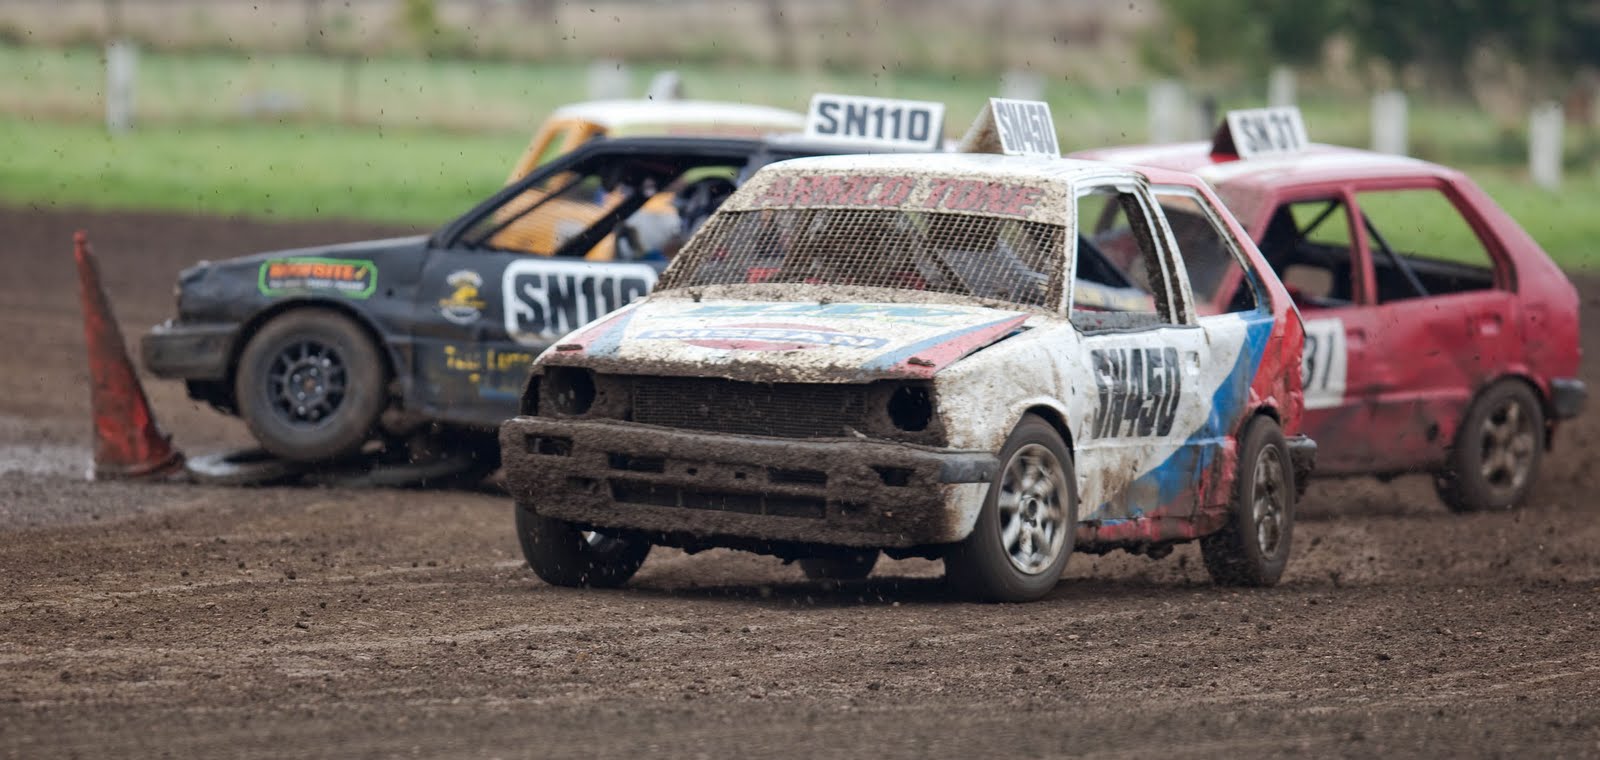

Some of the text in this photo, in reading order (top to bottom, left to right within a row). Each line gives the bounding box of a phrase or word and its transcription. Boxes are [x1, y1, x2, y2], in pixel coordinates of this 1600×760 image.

[816, 101, 931, 142] SN110
[996, 101, 1056, 154] SN450
[1091, 346, 1182, 440] SN450
